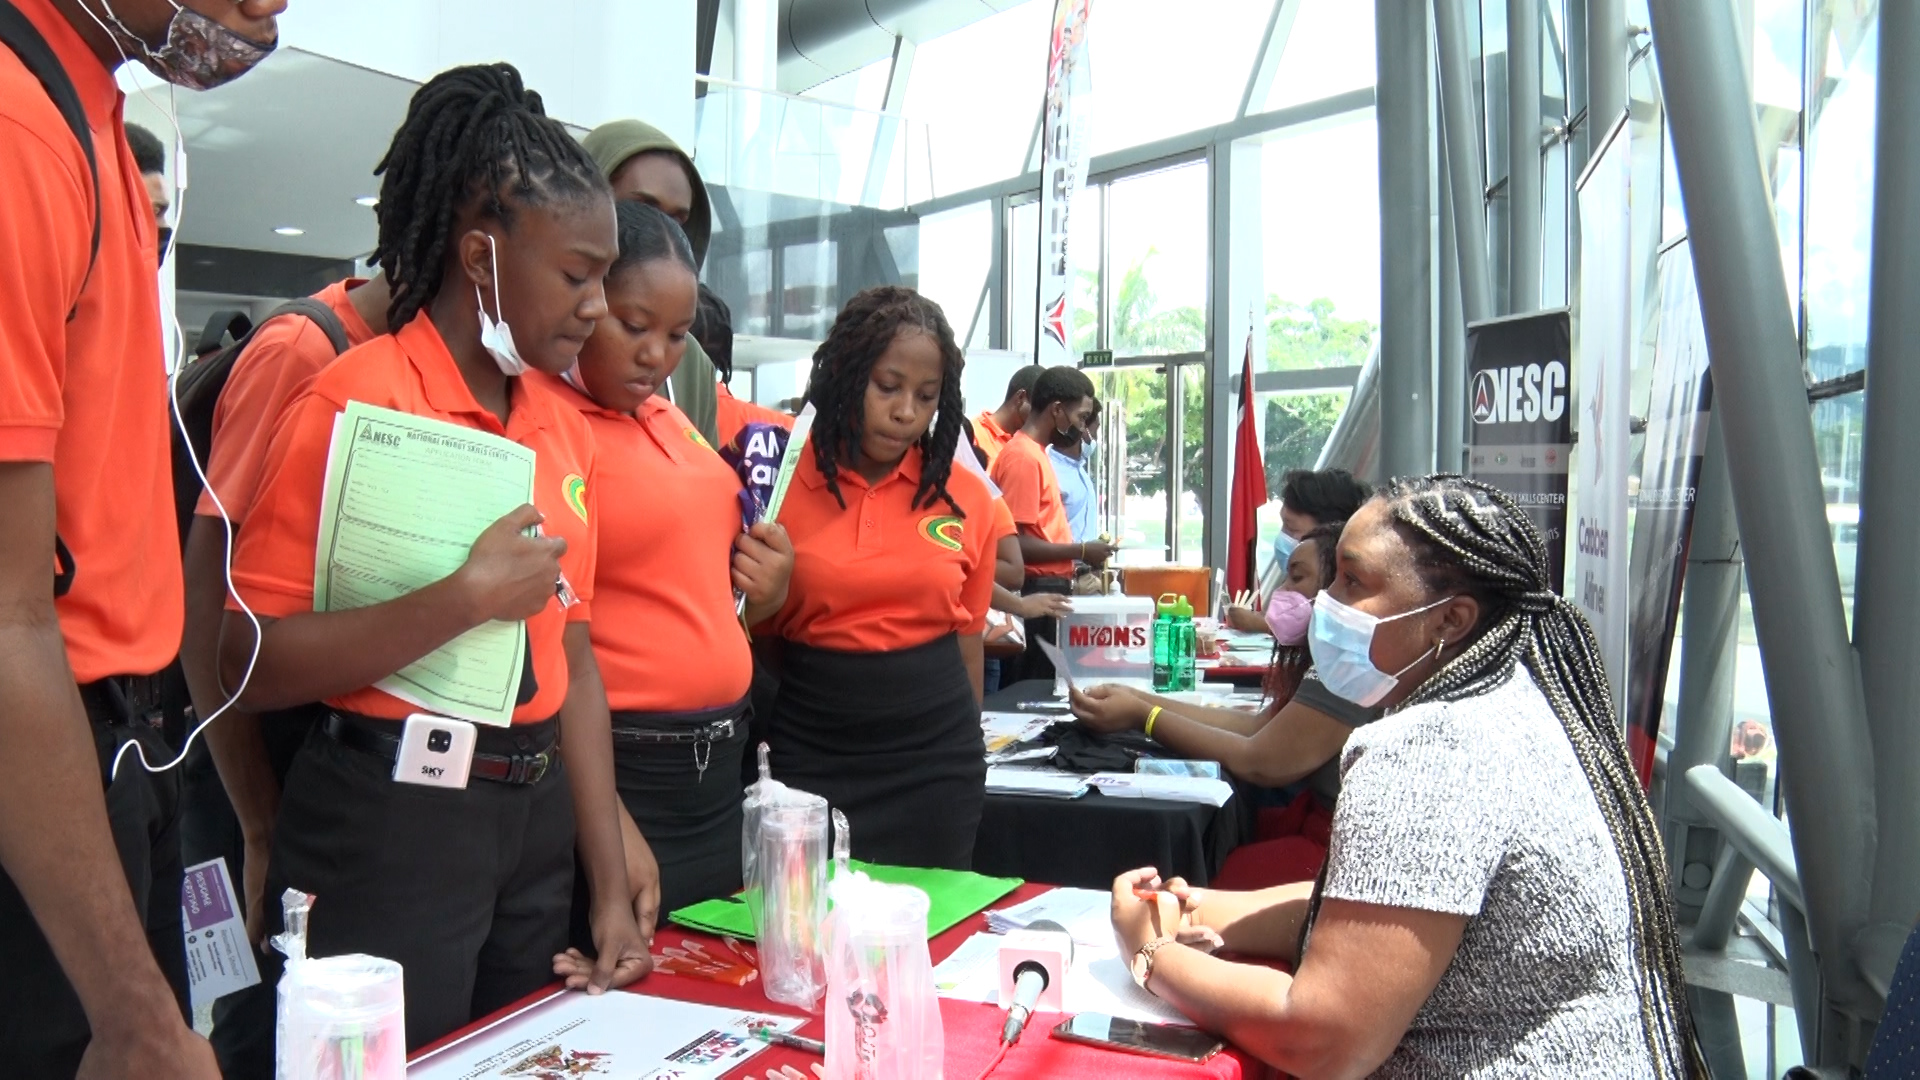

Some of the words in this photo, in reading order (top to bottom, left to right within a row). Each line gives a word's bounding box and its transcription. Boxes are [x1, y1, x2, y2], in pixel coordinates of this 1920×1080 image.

[1086, 354, 1110, 365] EXIT
[1471, 360, 1566, 424] NESC
[373, 431, 402, 448] NESC
[421, 765, 445, 777] SKY
